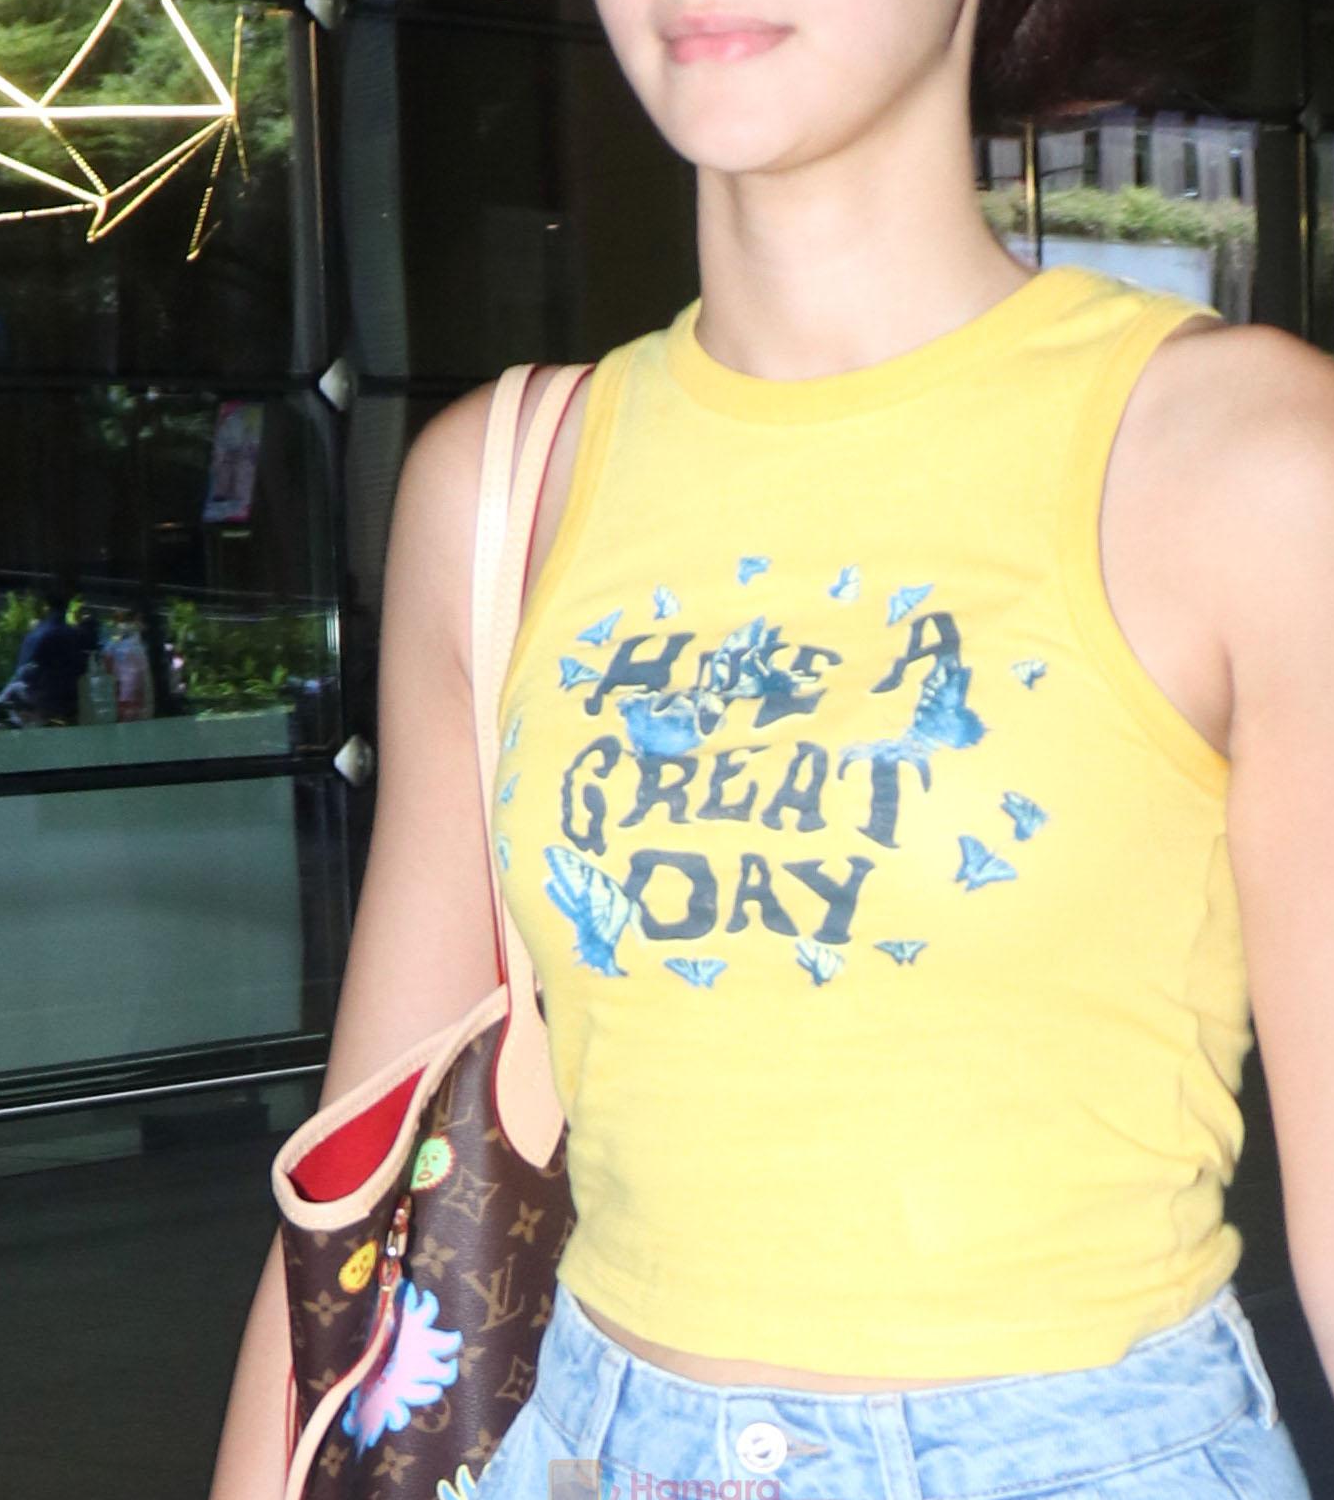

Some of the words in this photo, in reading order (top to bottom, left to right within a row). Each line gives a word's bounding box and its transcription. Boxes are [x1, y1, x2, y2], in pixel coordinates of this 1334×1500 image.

[870, 611, 965, 694] A
[562, 736, 932, 856] GREAT
[624, 850, 875, 944] DAY
